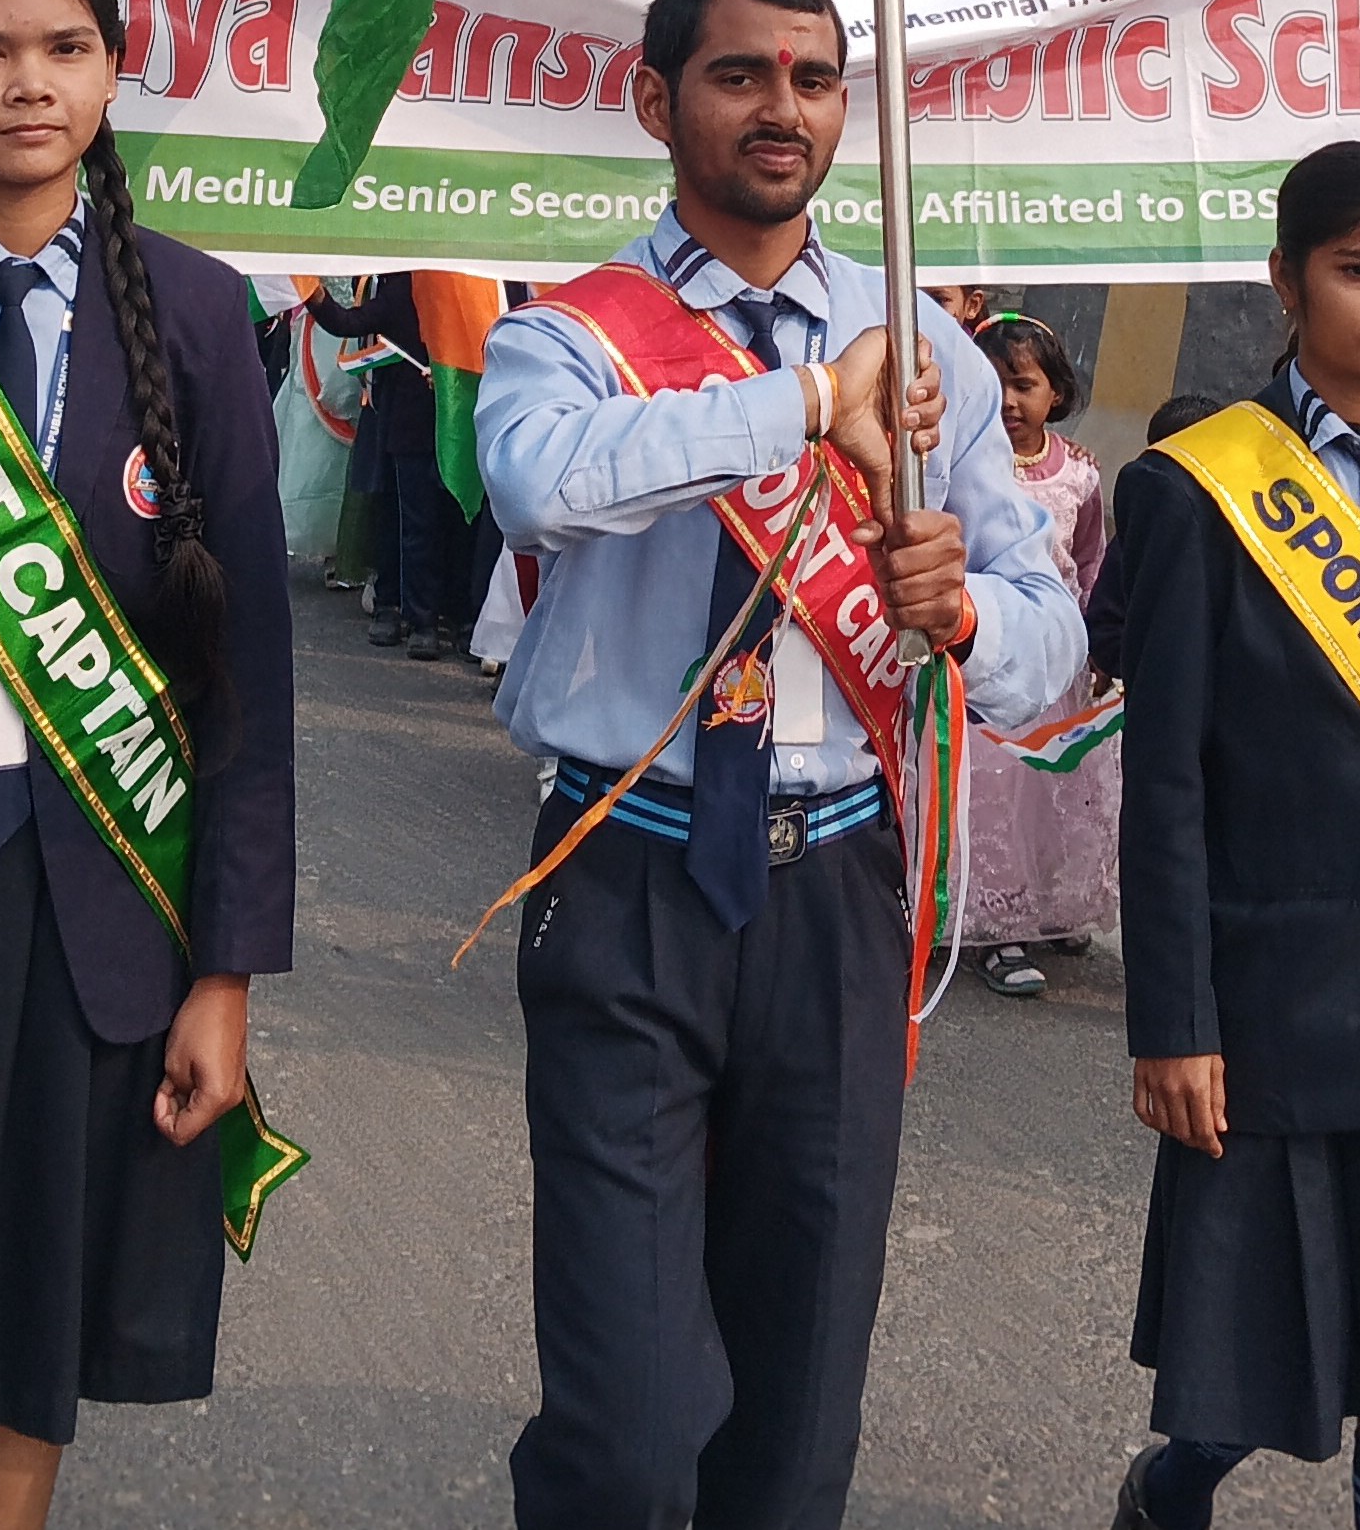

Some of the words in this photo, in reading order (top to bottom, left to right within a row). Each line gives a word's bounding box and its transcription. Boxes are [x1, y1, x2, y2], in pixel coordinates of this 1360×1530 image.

[145, 165, 292, 207] Mediu
[352, 174, 497, 217] Senior
[509, 182, 669, 222] Second
[918, 189, 1124, 225] Affiliated
[1141, 195, 1183, 224] to
[1199, 189, 1279, 221] CBS
[47, 398, 65, 444] PUBLIC
